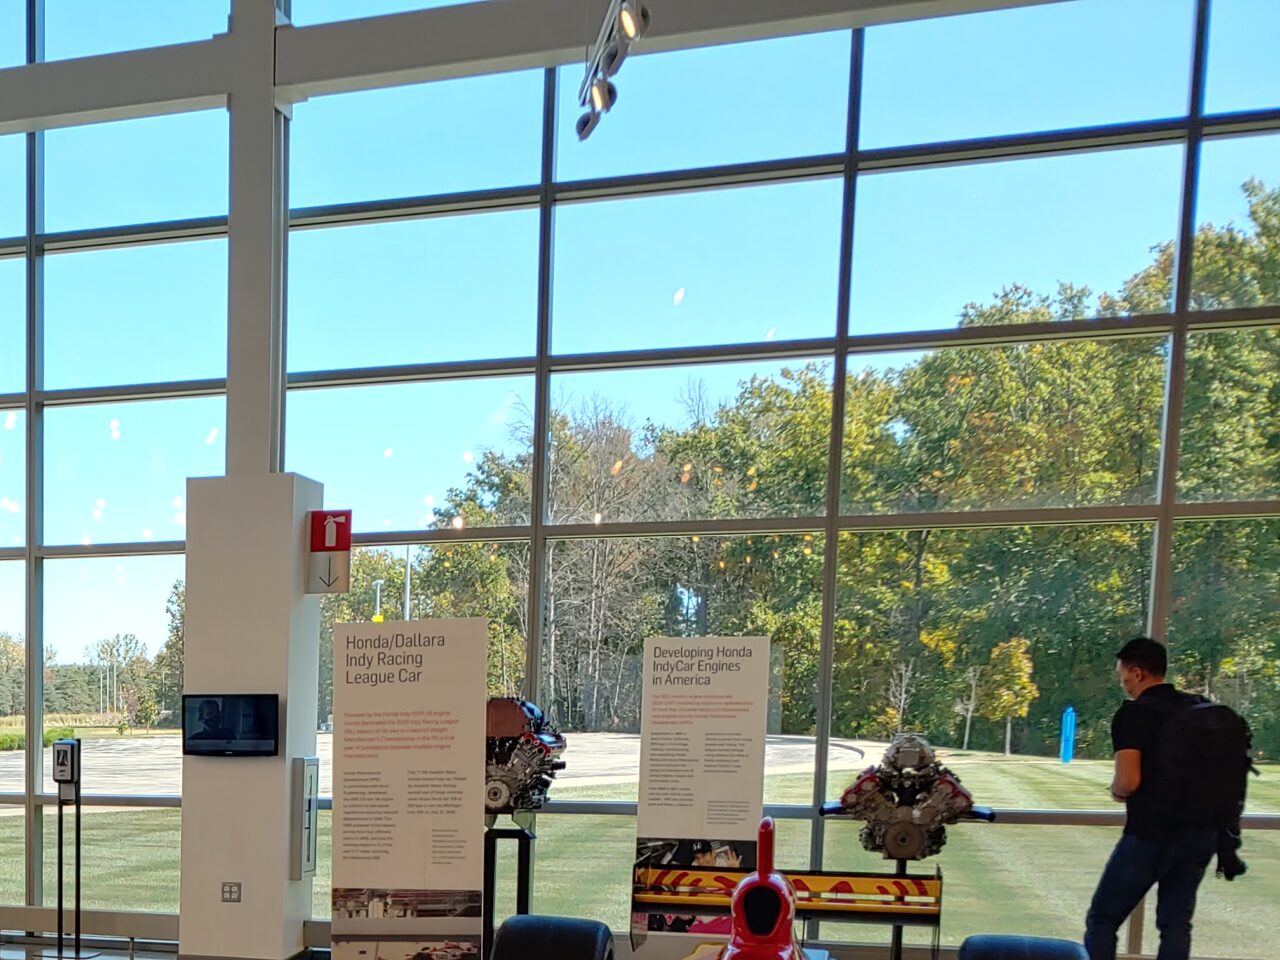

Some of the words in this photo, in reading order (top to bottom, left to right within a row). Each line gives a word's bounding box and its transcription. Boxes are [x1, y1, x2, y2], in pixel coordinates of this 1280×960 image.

[345, 632, 446, 651] Honda/Dallara
[345, 652, 374, 669] Indy
[377, 651, 423, 669] Racing
[653, 646, 714, 660] Developing
[716, 646, 753, 658] Honda
[652, 660, 694, 674] IndyCar
[697, 660, 741, 674] Engines
[345, 669, 395, 687] League
[398, 668, 423, 683] Car
[652, 674, 662, 686] in
[664, 674, 711, 686] America
